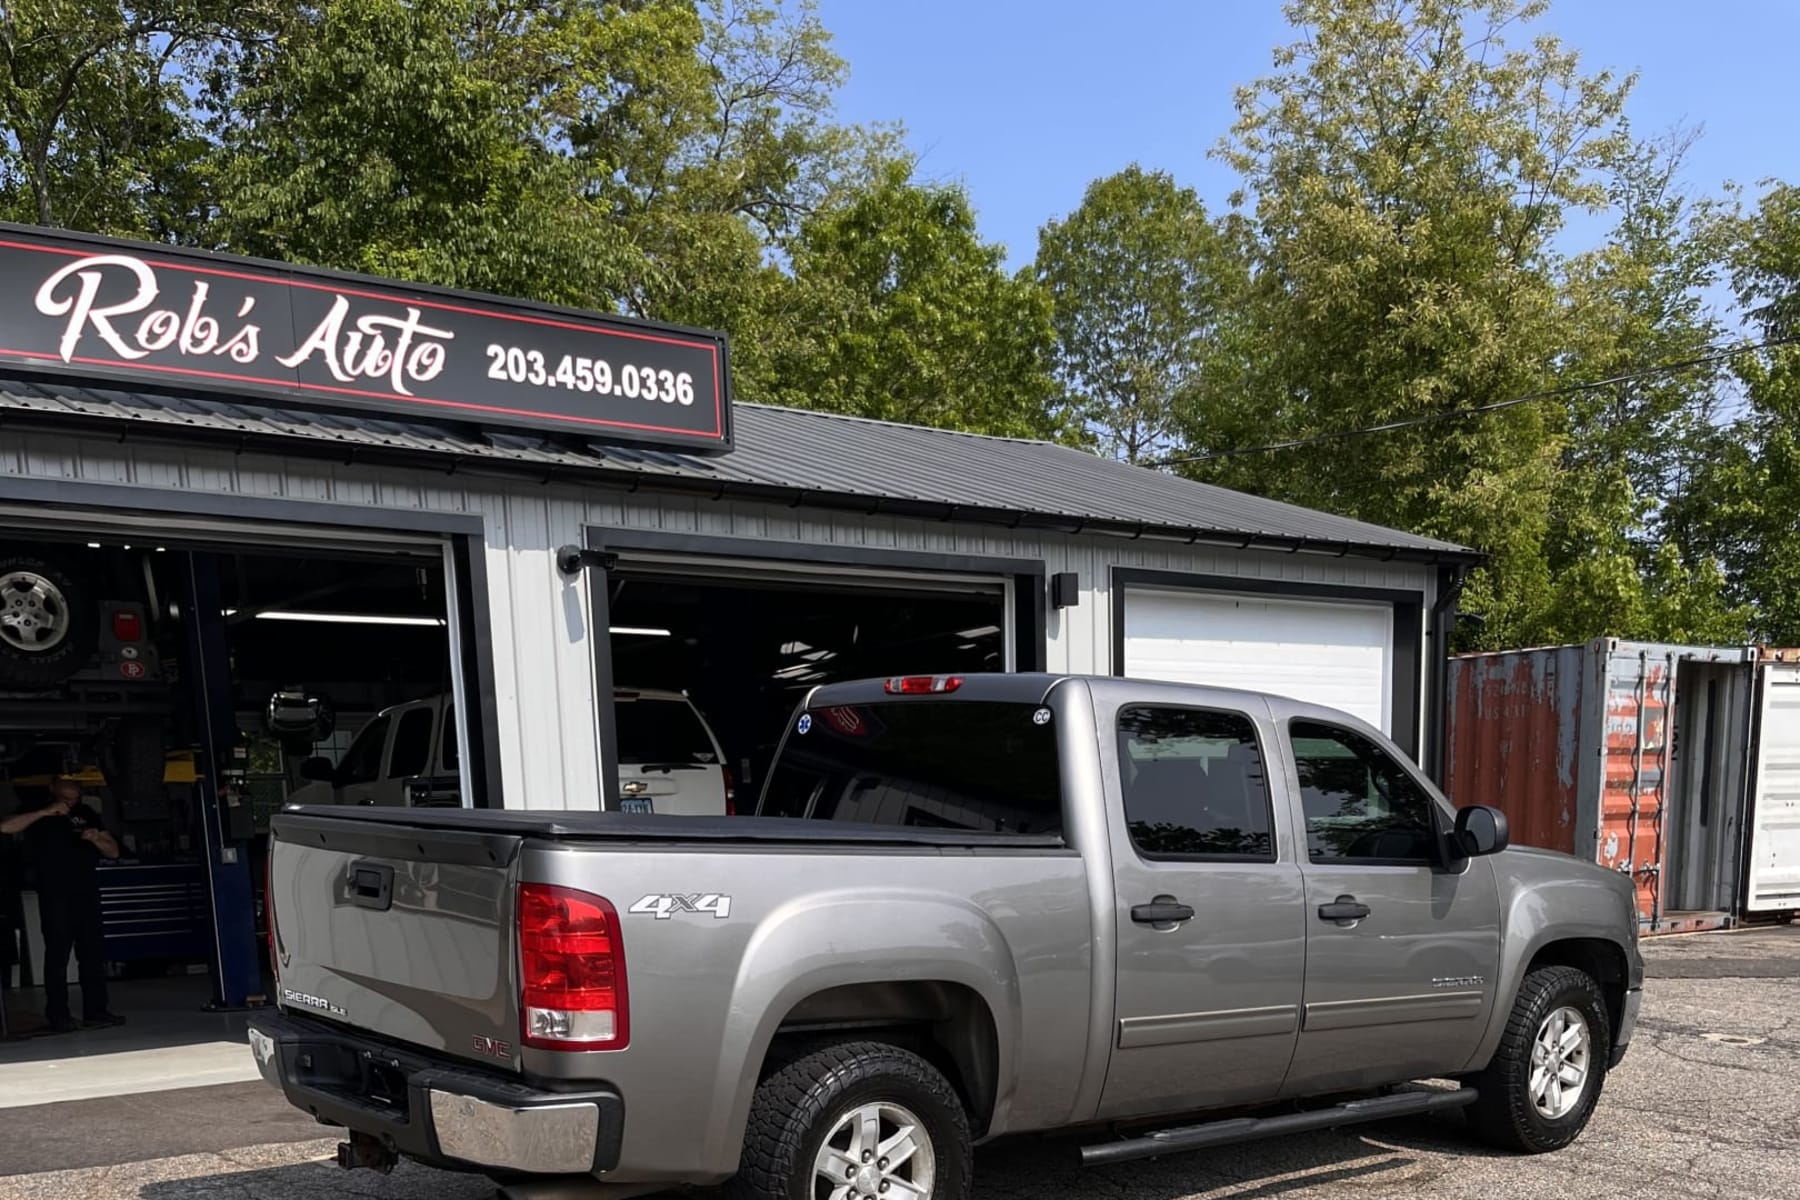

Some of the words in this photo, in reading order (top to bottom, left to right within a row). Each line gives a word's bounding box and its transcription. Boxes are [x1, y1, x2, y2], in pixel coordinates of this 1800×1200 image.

[35, 255, 260, 363] Rob's
[275, 294, 455, 396] Auto
[486, 344, 694, 406] 203.459.0336
[284, 989, 329, 1009] SIERRA
[472, 1034, 512, 1059] GMC
